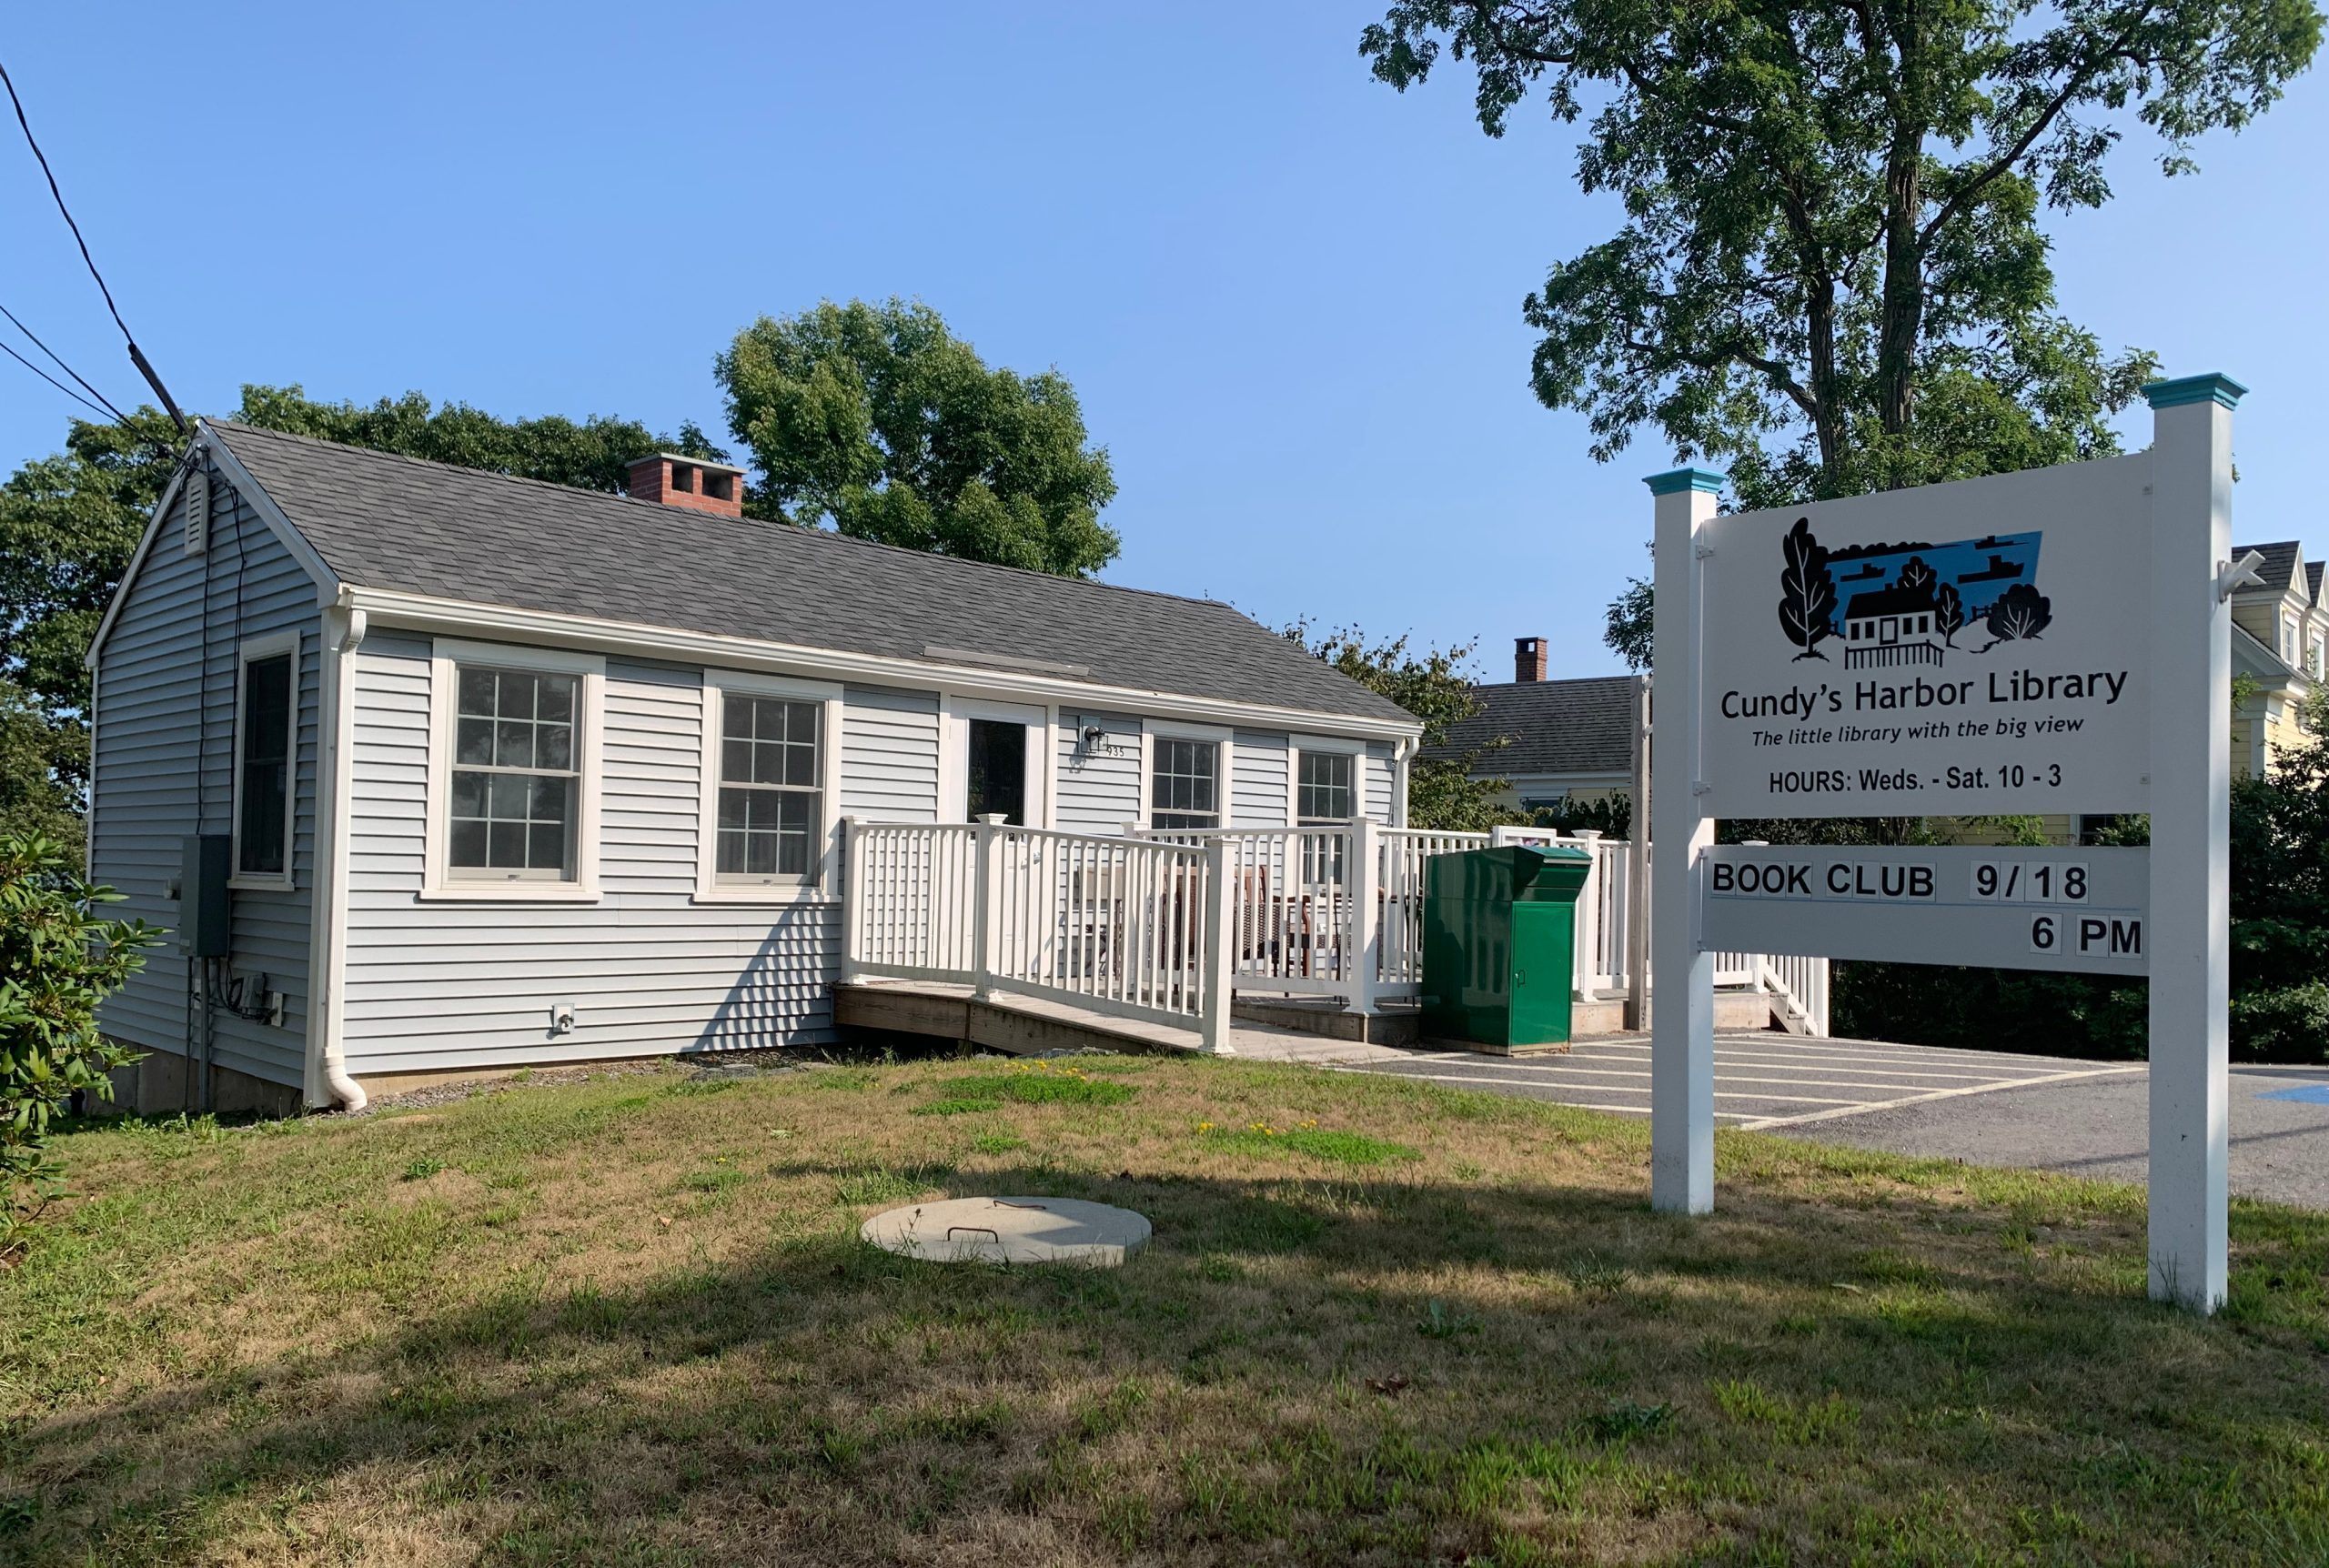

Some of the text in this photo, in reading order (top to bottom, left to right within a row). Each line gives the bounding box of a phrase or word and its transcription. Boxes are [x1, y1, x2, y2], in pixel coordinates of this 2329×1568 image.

[1720, 668, 2129, 722] Cundy’s Harbor Library
[1752, 715, 2085, 747] The little library with the big view
[1106, 747, 1124, 757] 935
[1769, 769, 1851, 794] HOURS:
[1858, 768, 1924, 791] Weds.
[1946, 766, 1990, 789] Sat.
[1998, 764, 2024, 789] 10
[2048, 763, 2062, 788] 3
[1712, 863, 2087, 900] BOOK CLUB 9/18
[2032, 916, 2142, 955] 6 PM
